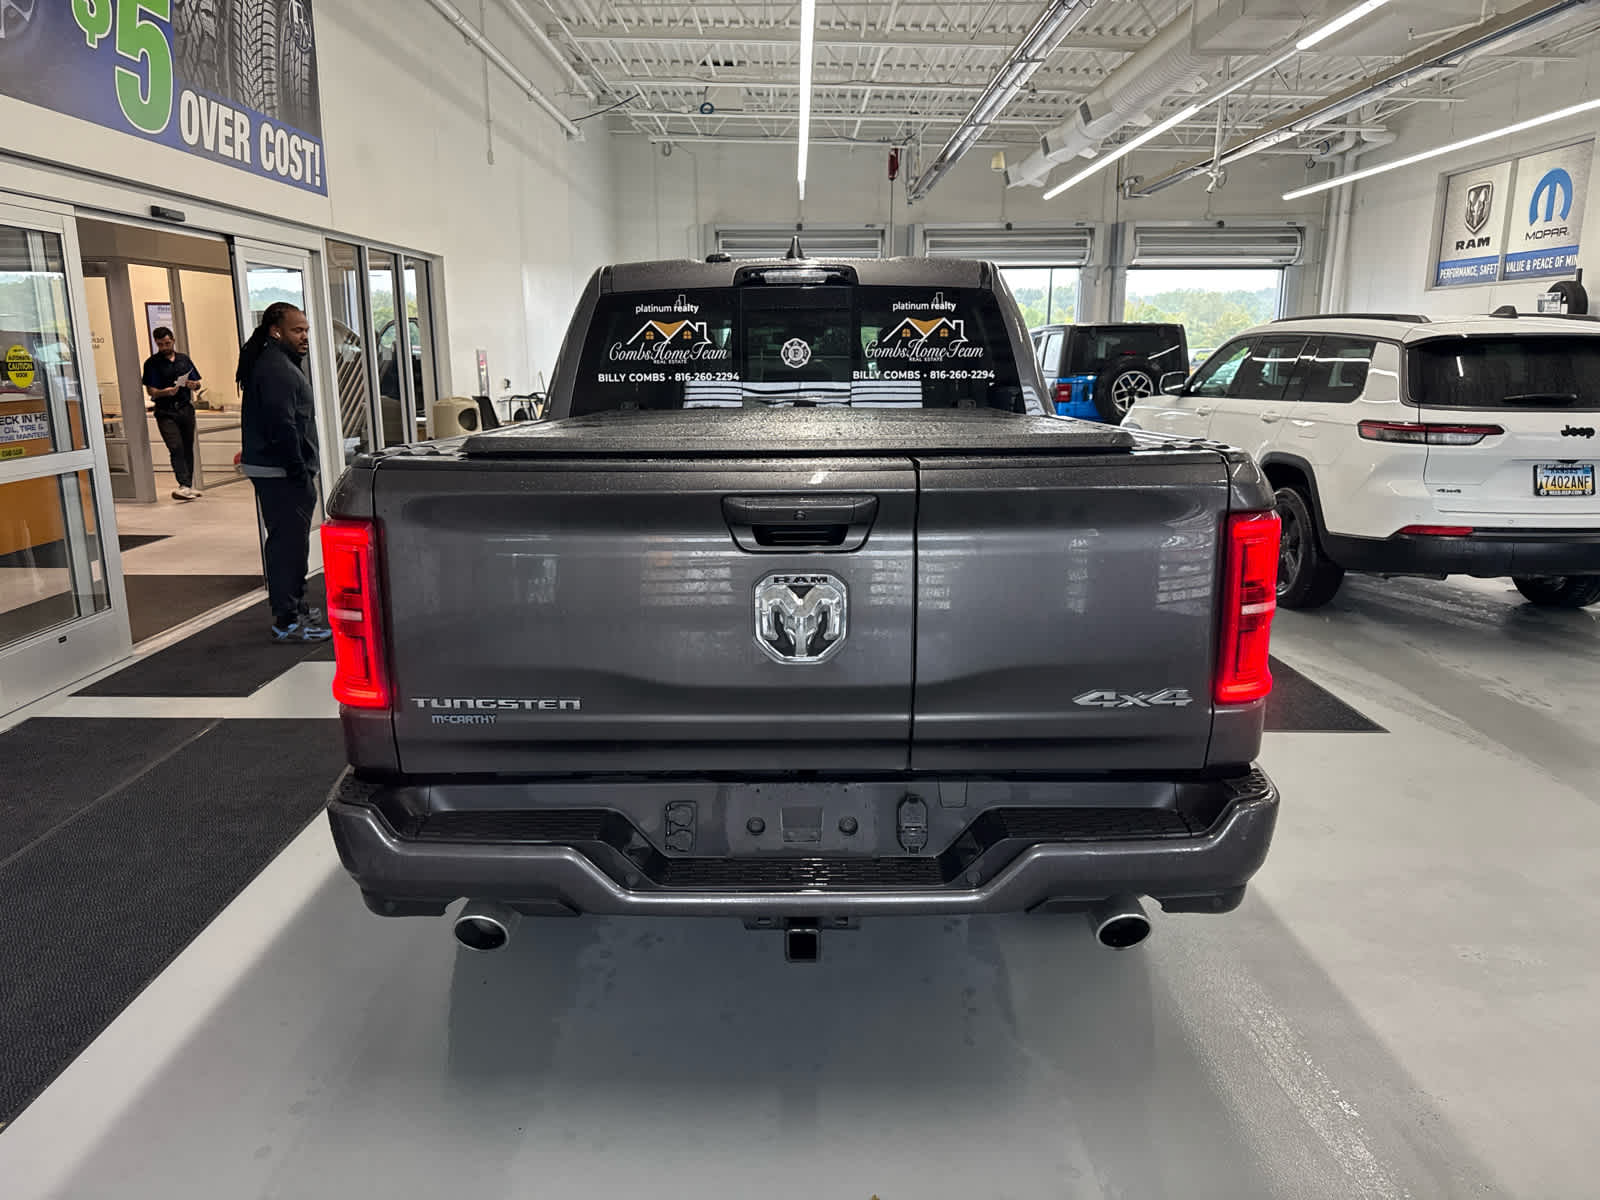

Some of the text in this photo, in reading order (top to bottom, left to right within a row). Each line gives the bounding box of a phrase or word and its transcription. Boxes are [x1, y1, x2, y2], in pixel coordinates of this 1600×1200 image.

[179, 89, 321, 187] OVER COST!
[1525, 227, 1568, 240] MOPAR
[1455, 236, 1491, 251] RAM
[1506, 260, 1524, 273] VALUE
[1533, 257, 1553, 271] PEACE
[1555, 255, 1564, 268] OF
[635, 303, 699, 314] platinum realty
[892, 301, 957, 312] platinum realty
[8, 362, 33, 371] CAUTION
[598, 372, 740, 382] BILLY COMBS 816-260-2294
[853, 370, 995, 380] BILLY COMBS 816-260-2294
[21, 414, 32, 423] IN
[20, 424, 36, 432] TIRE
[1560, 424, 1595, 439] Jeep
[411, 697, 581, 711] TUNGSTEN
[1072, 688, 1193, 708] 4x4
